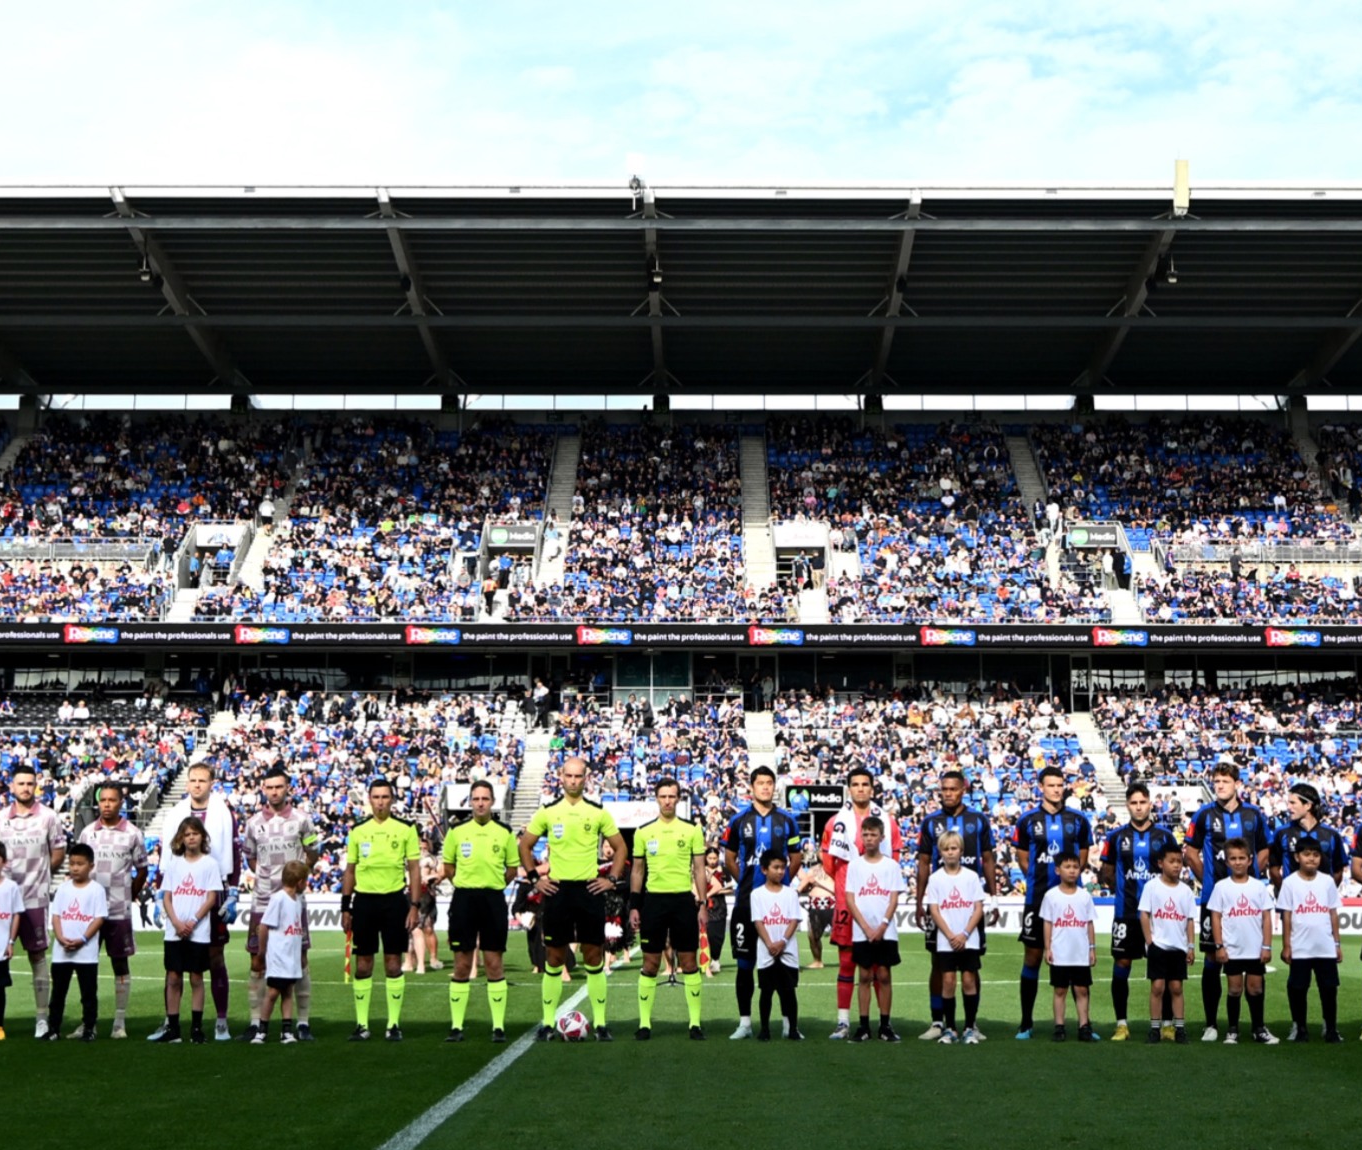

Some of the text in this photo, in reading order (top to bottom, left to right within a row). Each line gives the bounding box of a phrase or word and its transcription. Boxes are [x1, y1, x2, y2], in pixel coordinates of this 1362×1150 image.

[46, 632, 59, 640] use
[67, 629, 115, 642] Resene
[238, 629, 401, 642] Resene the paint the professionals use
[409, 629, 572, 643] Resene the paint the professionals use
[579, 630, 627, 643] Resene
[751, 630, 916, 644] Resene the paint the professionals use
[923, 631, 971, 644] Resene
[1095, 631, 1261, 645] Resene the paint the professionals use
[1268, 632, 1316, 645] Resene
[1324, 636, 1336, 645] the
[1338, 636, 1356, 646] paint
[811, 793, 842, 803] Media
[1025, 911, 1034, 927] 6
[1054, 917, 1087, 928] Anchor
[736, 922, 744, 940] 2
